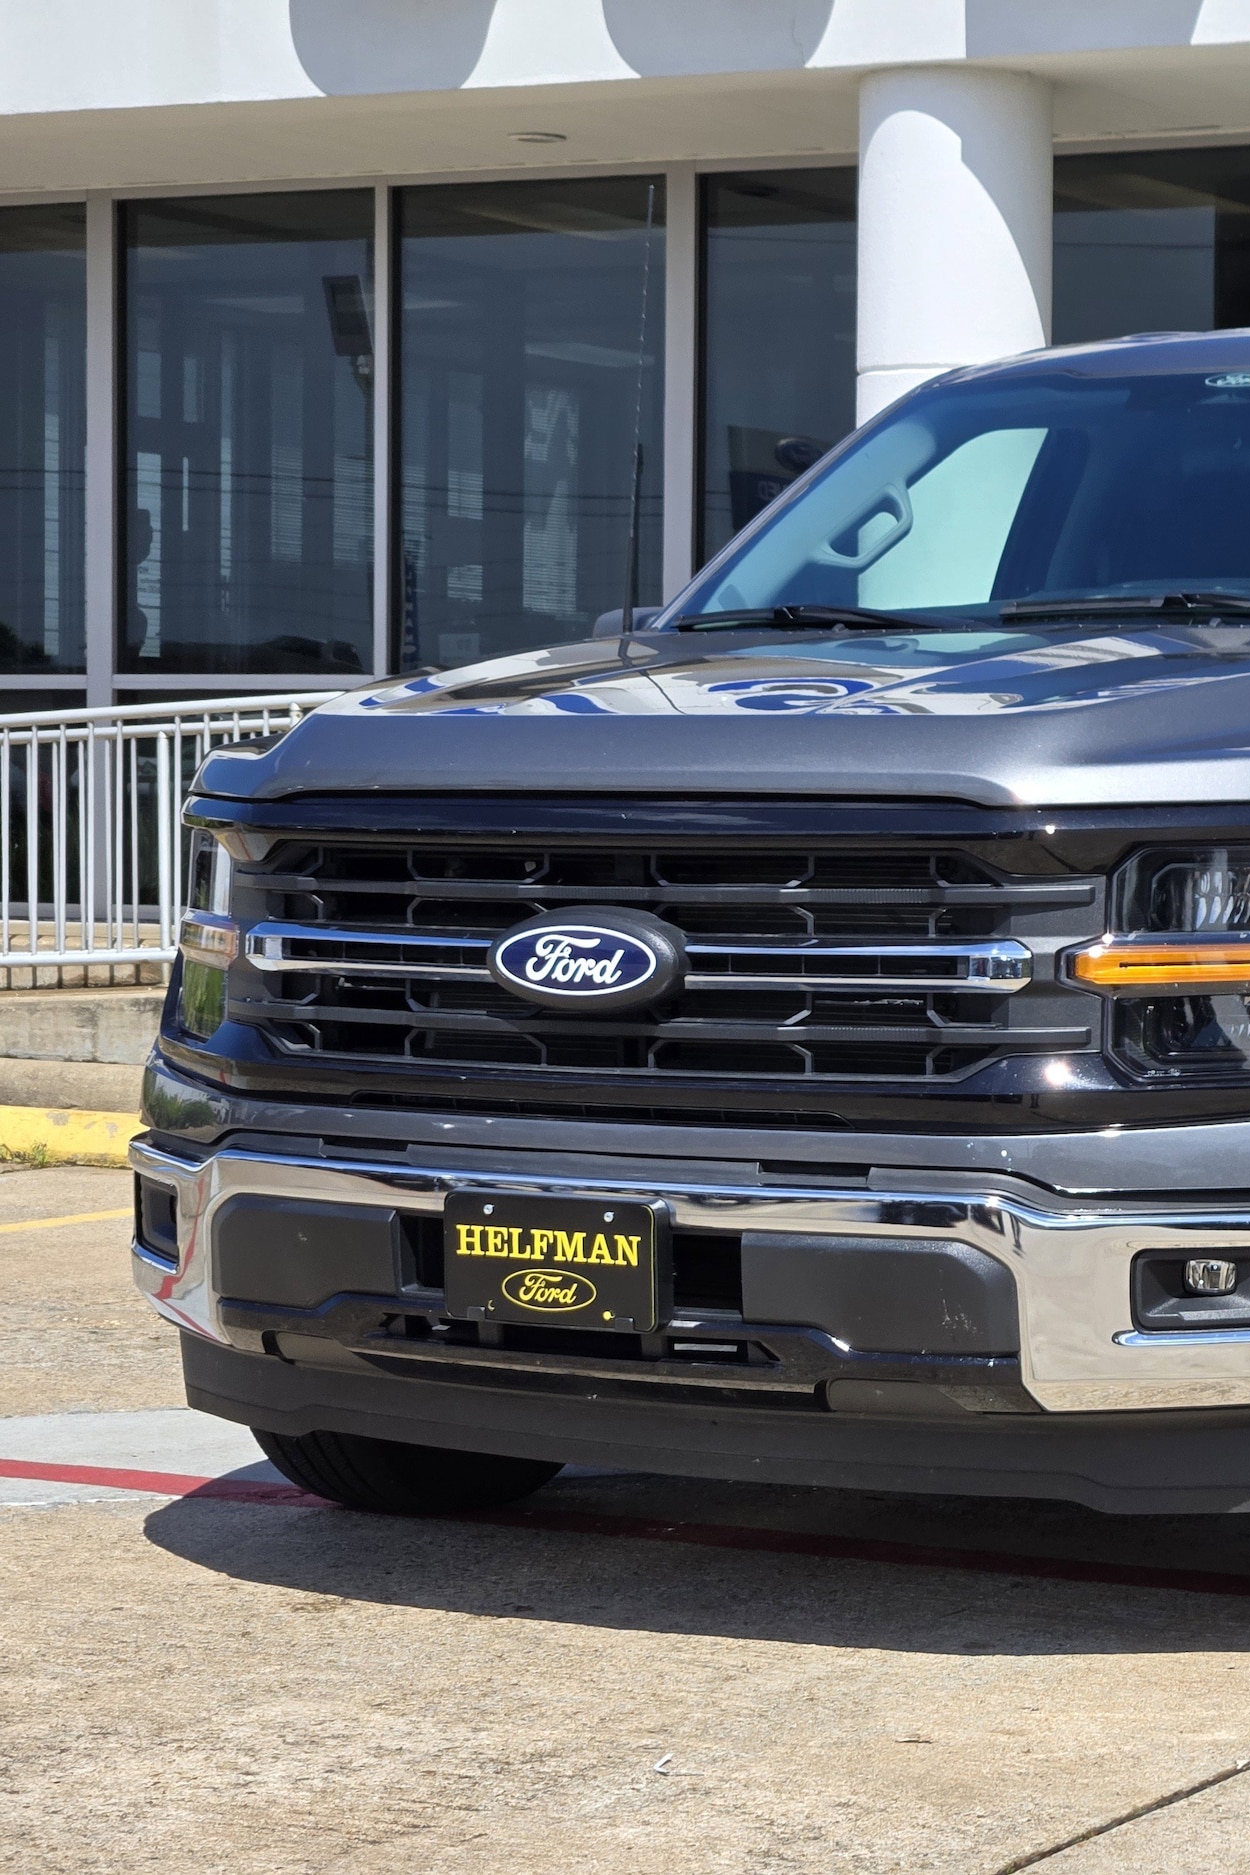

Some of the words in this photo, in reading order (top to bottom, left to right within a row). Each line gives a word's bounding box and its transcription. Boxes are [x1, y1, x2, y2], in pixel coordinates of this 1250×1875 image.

[525, 934, 626, 985] Ford
[456, 1223, 642, 1267] HELFMAN
[518, 1273, 578, 1304] Ford
